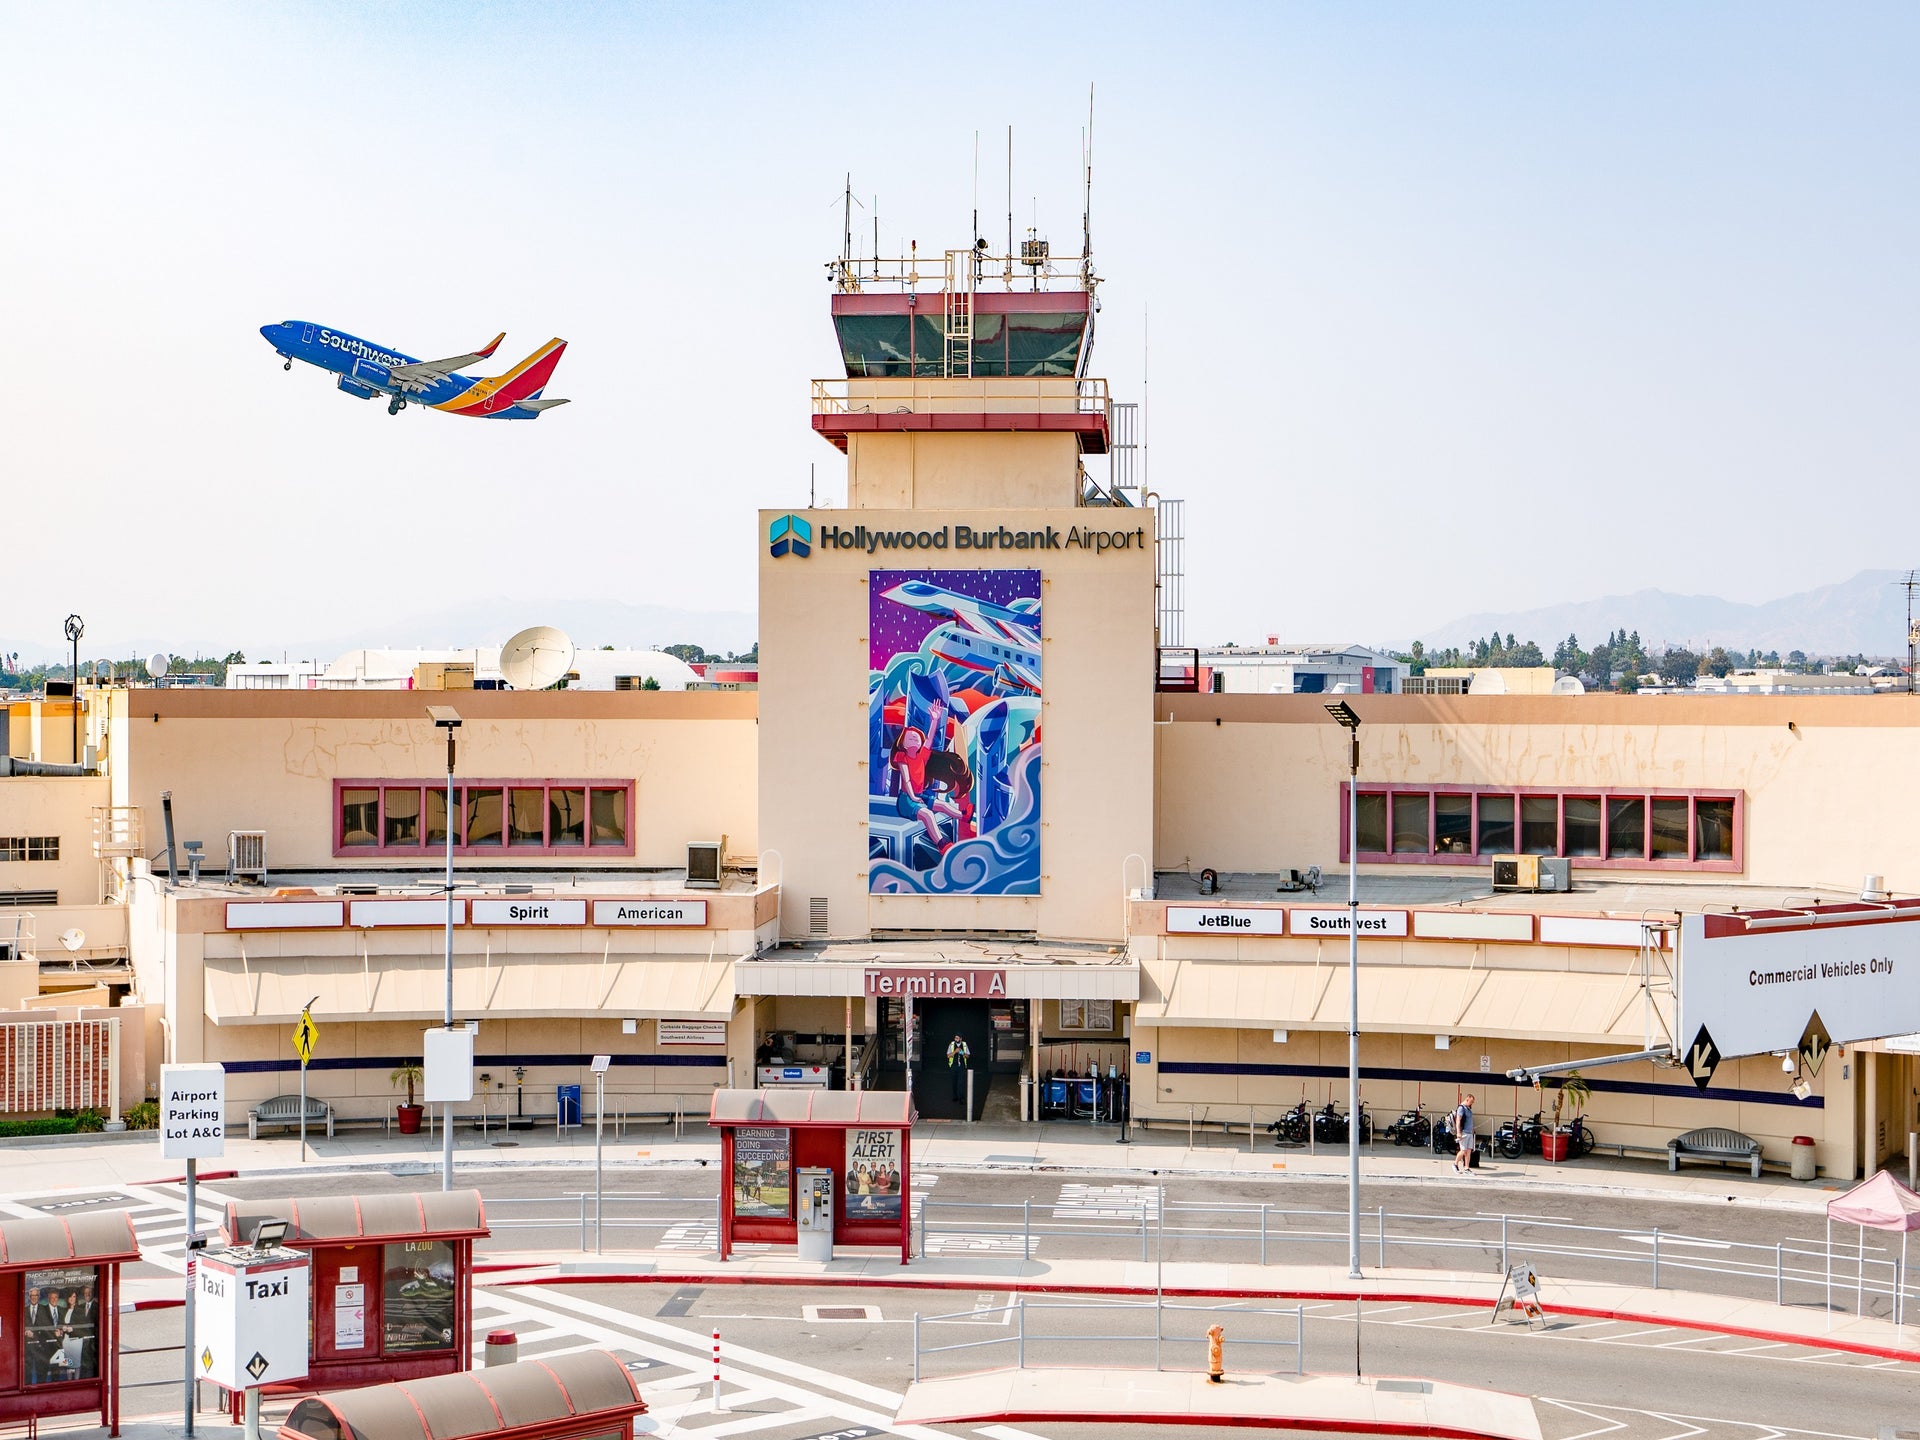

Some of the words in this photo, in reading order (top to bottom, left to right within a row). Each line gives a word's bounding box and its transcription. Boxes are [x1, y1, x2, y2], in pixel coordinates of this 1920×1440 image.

[820, 525, 948, 554] Hollywood
[955, 525, 1060, 549] Burbank
[1064, 525, 1144, 554] Airport
[509, 906, 549, 921] Spirit
[617, 907, 683, 919] American
[1198, 915, 1252, 928] JetBlue
[1749, 964, 1817, 986] Commercial
[1820, 960, 1867, 979] Vehicles
[1870, 956, 1894, 975] Only
[865, 970, 975, 994] Terminal
[988, 972, 1006, 995] A
[171, 1090, 218, 1103] Airport
[169, 1109, 219, 1122] Parking
[167, 1128, 188, 1139] Lot
[192, 1127, 221, 1138] A&C
[736, 1129, 775, 1138] LEARNING
[856, 1131, 893, 1144] FIRST
[736, 1140, 761, 1150] DOING
[852, 1144, 895, 1158] ALERT
[736, 1152, 785, 1162] SUCCEEDING
[405, 1242, 416, 1252] LA
[201, 1273, 224, 1298] Taxi
[245, 1276, 288, 1300] Taxi
